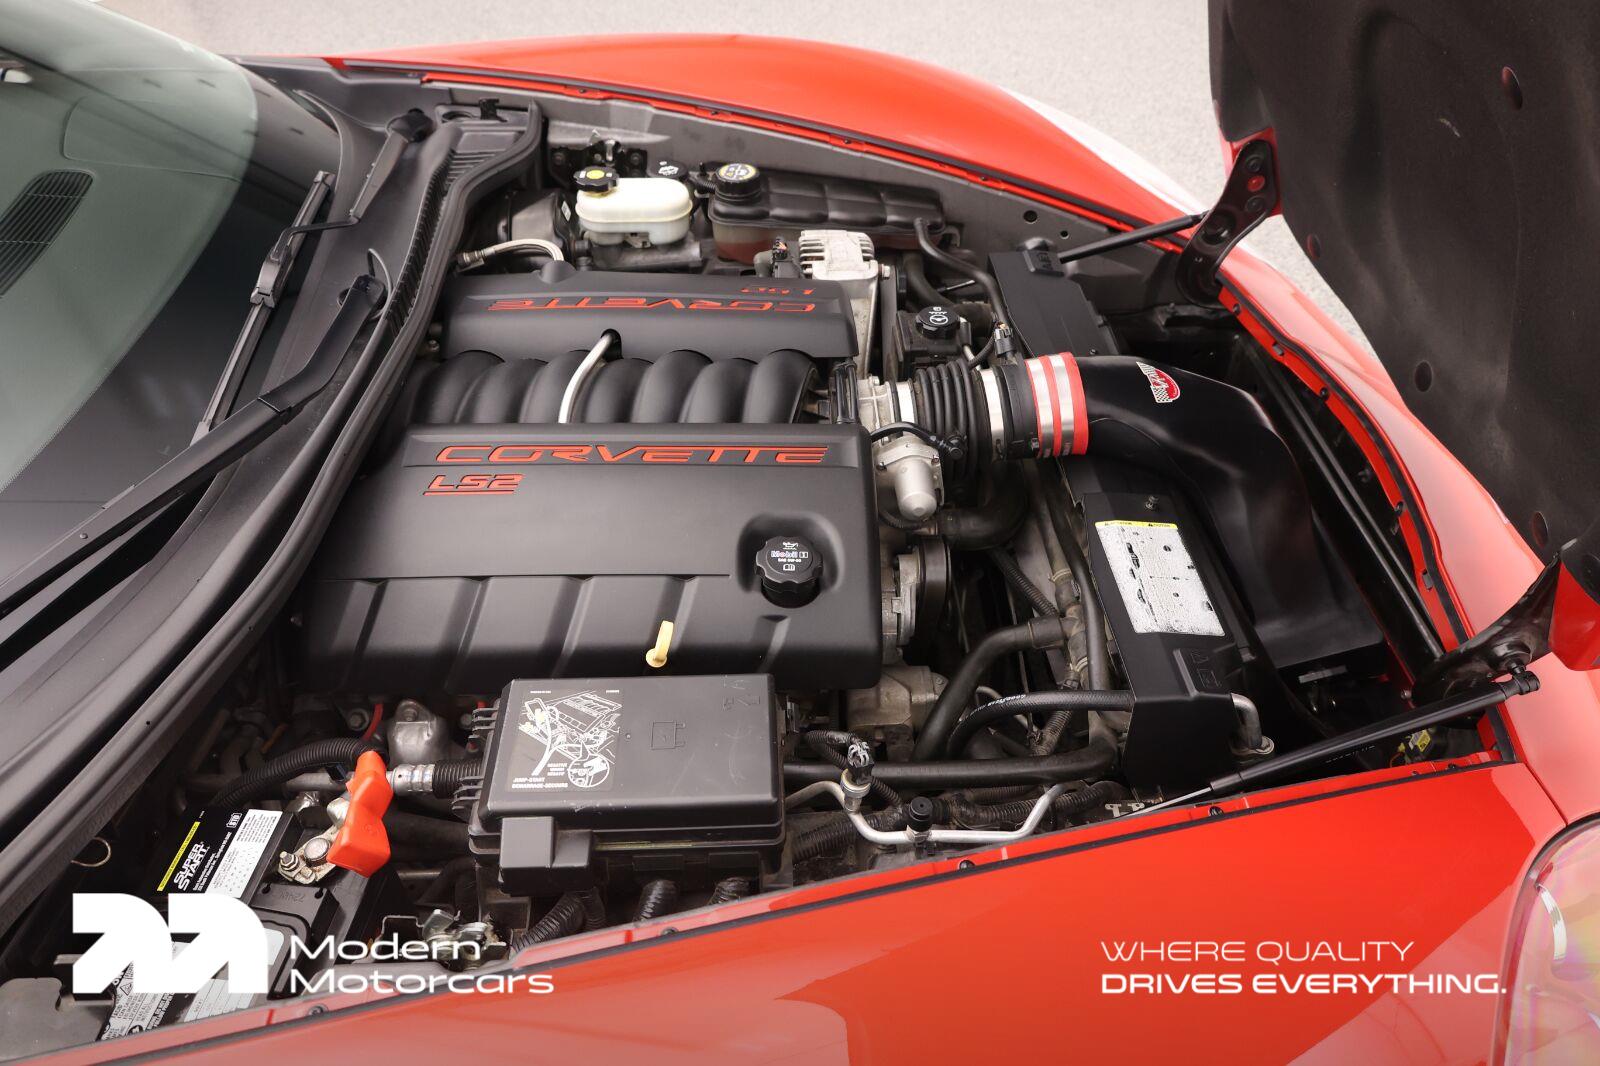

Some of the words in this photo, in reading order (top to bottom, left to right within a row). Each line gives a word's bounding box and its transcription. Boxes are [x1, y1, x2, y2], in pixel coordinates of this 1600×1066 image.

[487, 297, 815, 312] CORVETTE
[435, 444, 829, 464] CORVETTE
[426, 473, 525, 491] LS2
[770, 550, 798, 558] Mobil
[173, 843, 201, 884] SUPER
[178, 844, 208, 891] START
